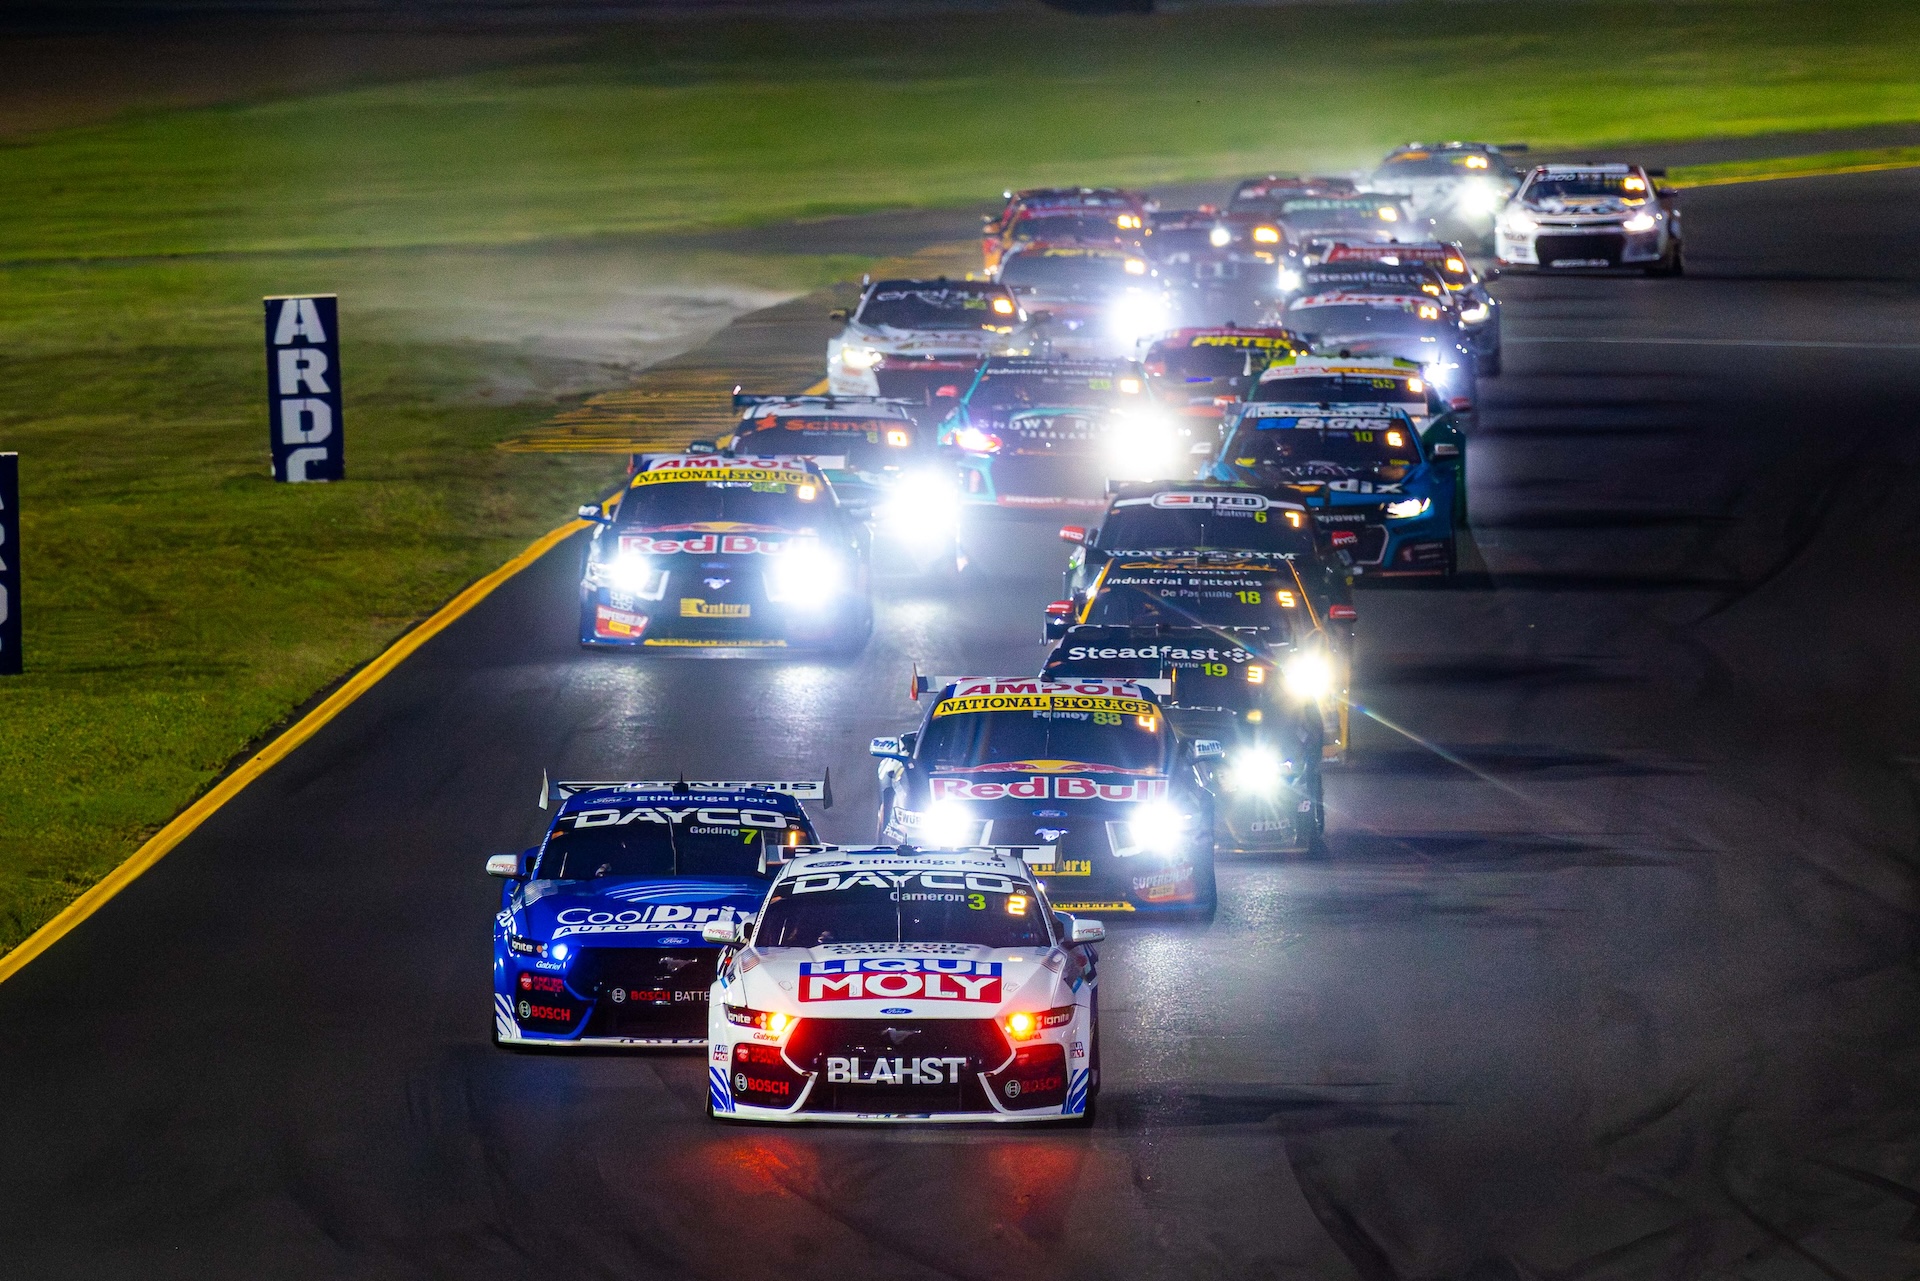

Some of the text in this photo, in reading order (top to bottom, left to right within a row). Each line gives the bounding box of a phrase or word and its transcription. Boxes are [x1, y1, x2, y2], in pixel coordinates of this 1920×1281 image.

[1353, 431, 1374, 443] 10
[639, 470, 729, 484] NATIONAL
[1328, 479, 1402, 494] dix
[1193, 496, 1257, 506] ENZED
[1254, 511, 1268, 524] 6
[618, 535, 718, 554] Red
[1107, 577, 1263, 587] Industrial Batteries
[1235, 591, 1262, 605] 18
[1068, 645, 1219, 661] Steadfast
[1201, 662, 1229, 677] 19
[960, 683, 1138, 698] AMPOL
[941, 697, 1047, 713] NATIONAL
[1053, 697, 1150, 715] STORAGE
[1093, 711, 1123, 726] 88
[930, 777, 1169, 802] Red Bull
[637, 795, 778, 805] Etheridge Ford
[574, 807, 788, 829] DAYCO
[690, 826, 758, 845] Golding 7
[859, 857, 1006, 869] Etheridge Ford
[792, 871, 1014, 894] DAYCO
[889, 890, 986, 911] Cameron 3
[1007, 895, 1027, 915] 2
[560, 923, 705, 934] AUTO PAR
[810, 959, 992, 976] LIQUI
[809, 974, 999, 1000] MOLY
[630, 991, 711, 1001] BOSCH BATTE
[531, 1005, 571, 1021] BOSCH
[753, 1032, 780, 1043] Gabriel
[826, 1057, 967, 1085] BLAHST
[748, 1077, 789, 1095] BOSCH
